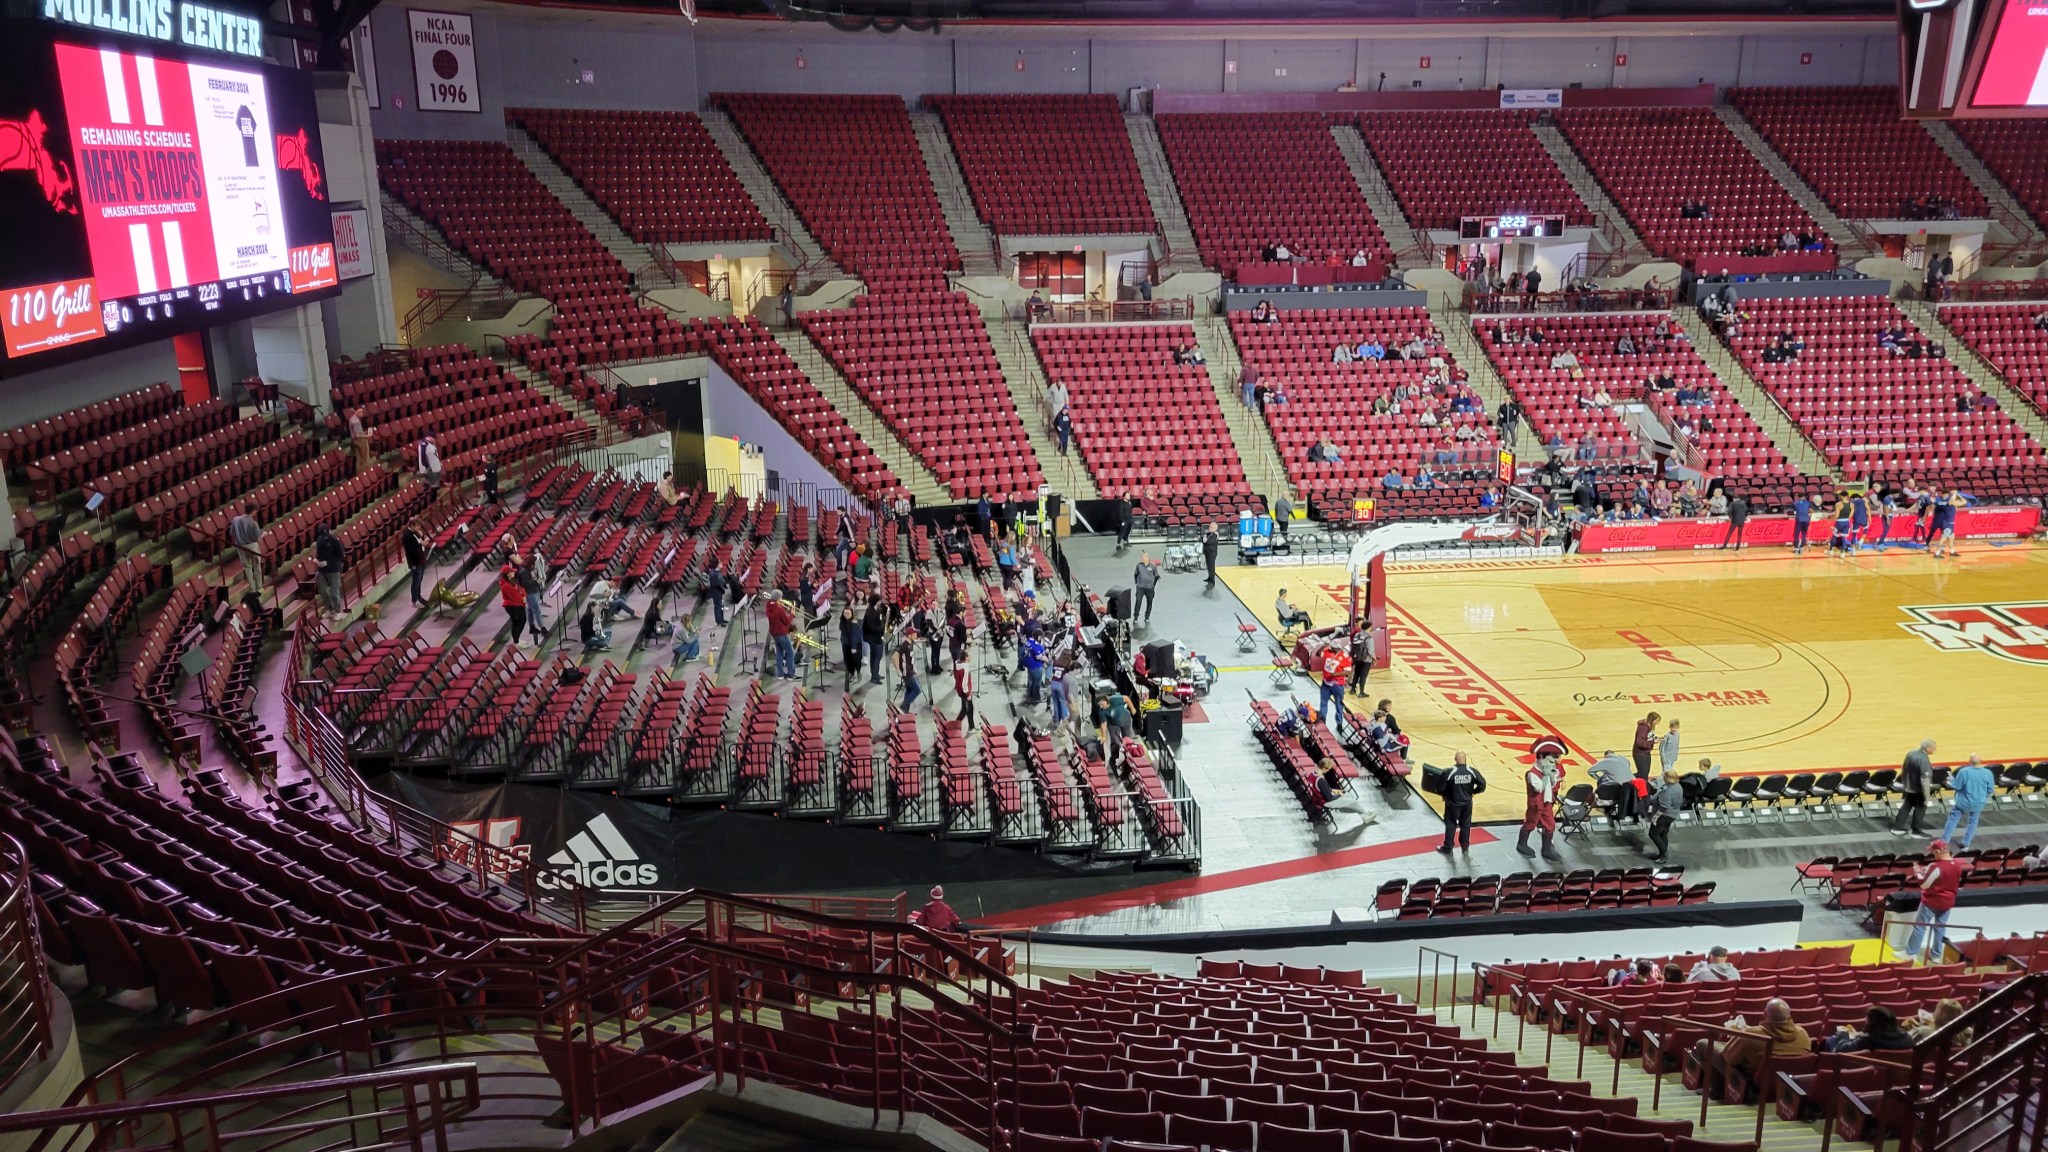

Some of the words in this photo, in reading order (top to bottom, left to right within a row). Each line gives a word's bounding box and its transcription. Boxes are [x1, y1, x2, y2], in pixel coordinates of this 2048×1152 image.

[181, 3, 261, 57] CENTER
[427, 17, 455, 32] NCAA
[415, 32, 443, 44] FINAL
[445, 33, 471, 46] FOUR
[208, 78, 237, 92] FEBRUARY
[236, 82, 249, 94] 2024
[430, 83, 467, 104] 1996
[81, 127, 142, 146] REMAINING
[143, 130, 192, 148] SCHEDULE
[81, 149, 145, 203] MEN'S
[143, 150, 202, 200] HOOPS
[102, 202, 196, 218] UMASSATHLETICS.COM/TICKETS
[1500, 216, 1527, 228] 22:23
[333, 214, 358, 249] HOTEL
[1490, 226, 1498, 238] 0
[1535, 225, 1542, 237] 0
[237, 246, 255, 258] MARCH
[256, 243, 268, 255] 2024
[338, 250, 360, 264] UMASS
[292, 249, 309, 273] 110
[311, 247, 330, 277] Grill
[258, 285, 263, 297] 4
[274, 276, 280, 290] 0
[198, 283, 219, 302] 22:23
[244, 288, 249, 301] 0
[11, 293, 46, 327] 110
[52, 285, 91, 329] Grill
[122, 306, 129, 323] 0
[146, 307, 152, 321] 4
[165, 303, 171, 317] 0
[1357, 510, 1369, 519] 30
[1384, 556, 1605, 572] UMASSATHLETICS.COM
[1319, 584, 1580, 767] ASSACHUSTS
[1573, 691, 1632, 706] Jack
[1630, 689, 1769, 705] LEAMAN
[1711, 699, 1771, 707] COURT
[536, 859, 659, 890] adidas
